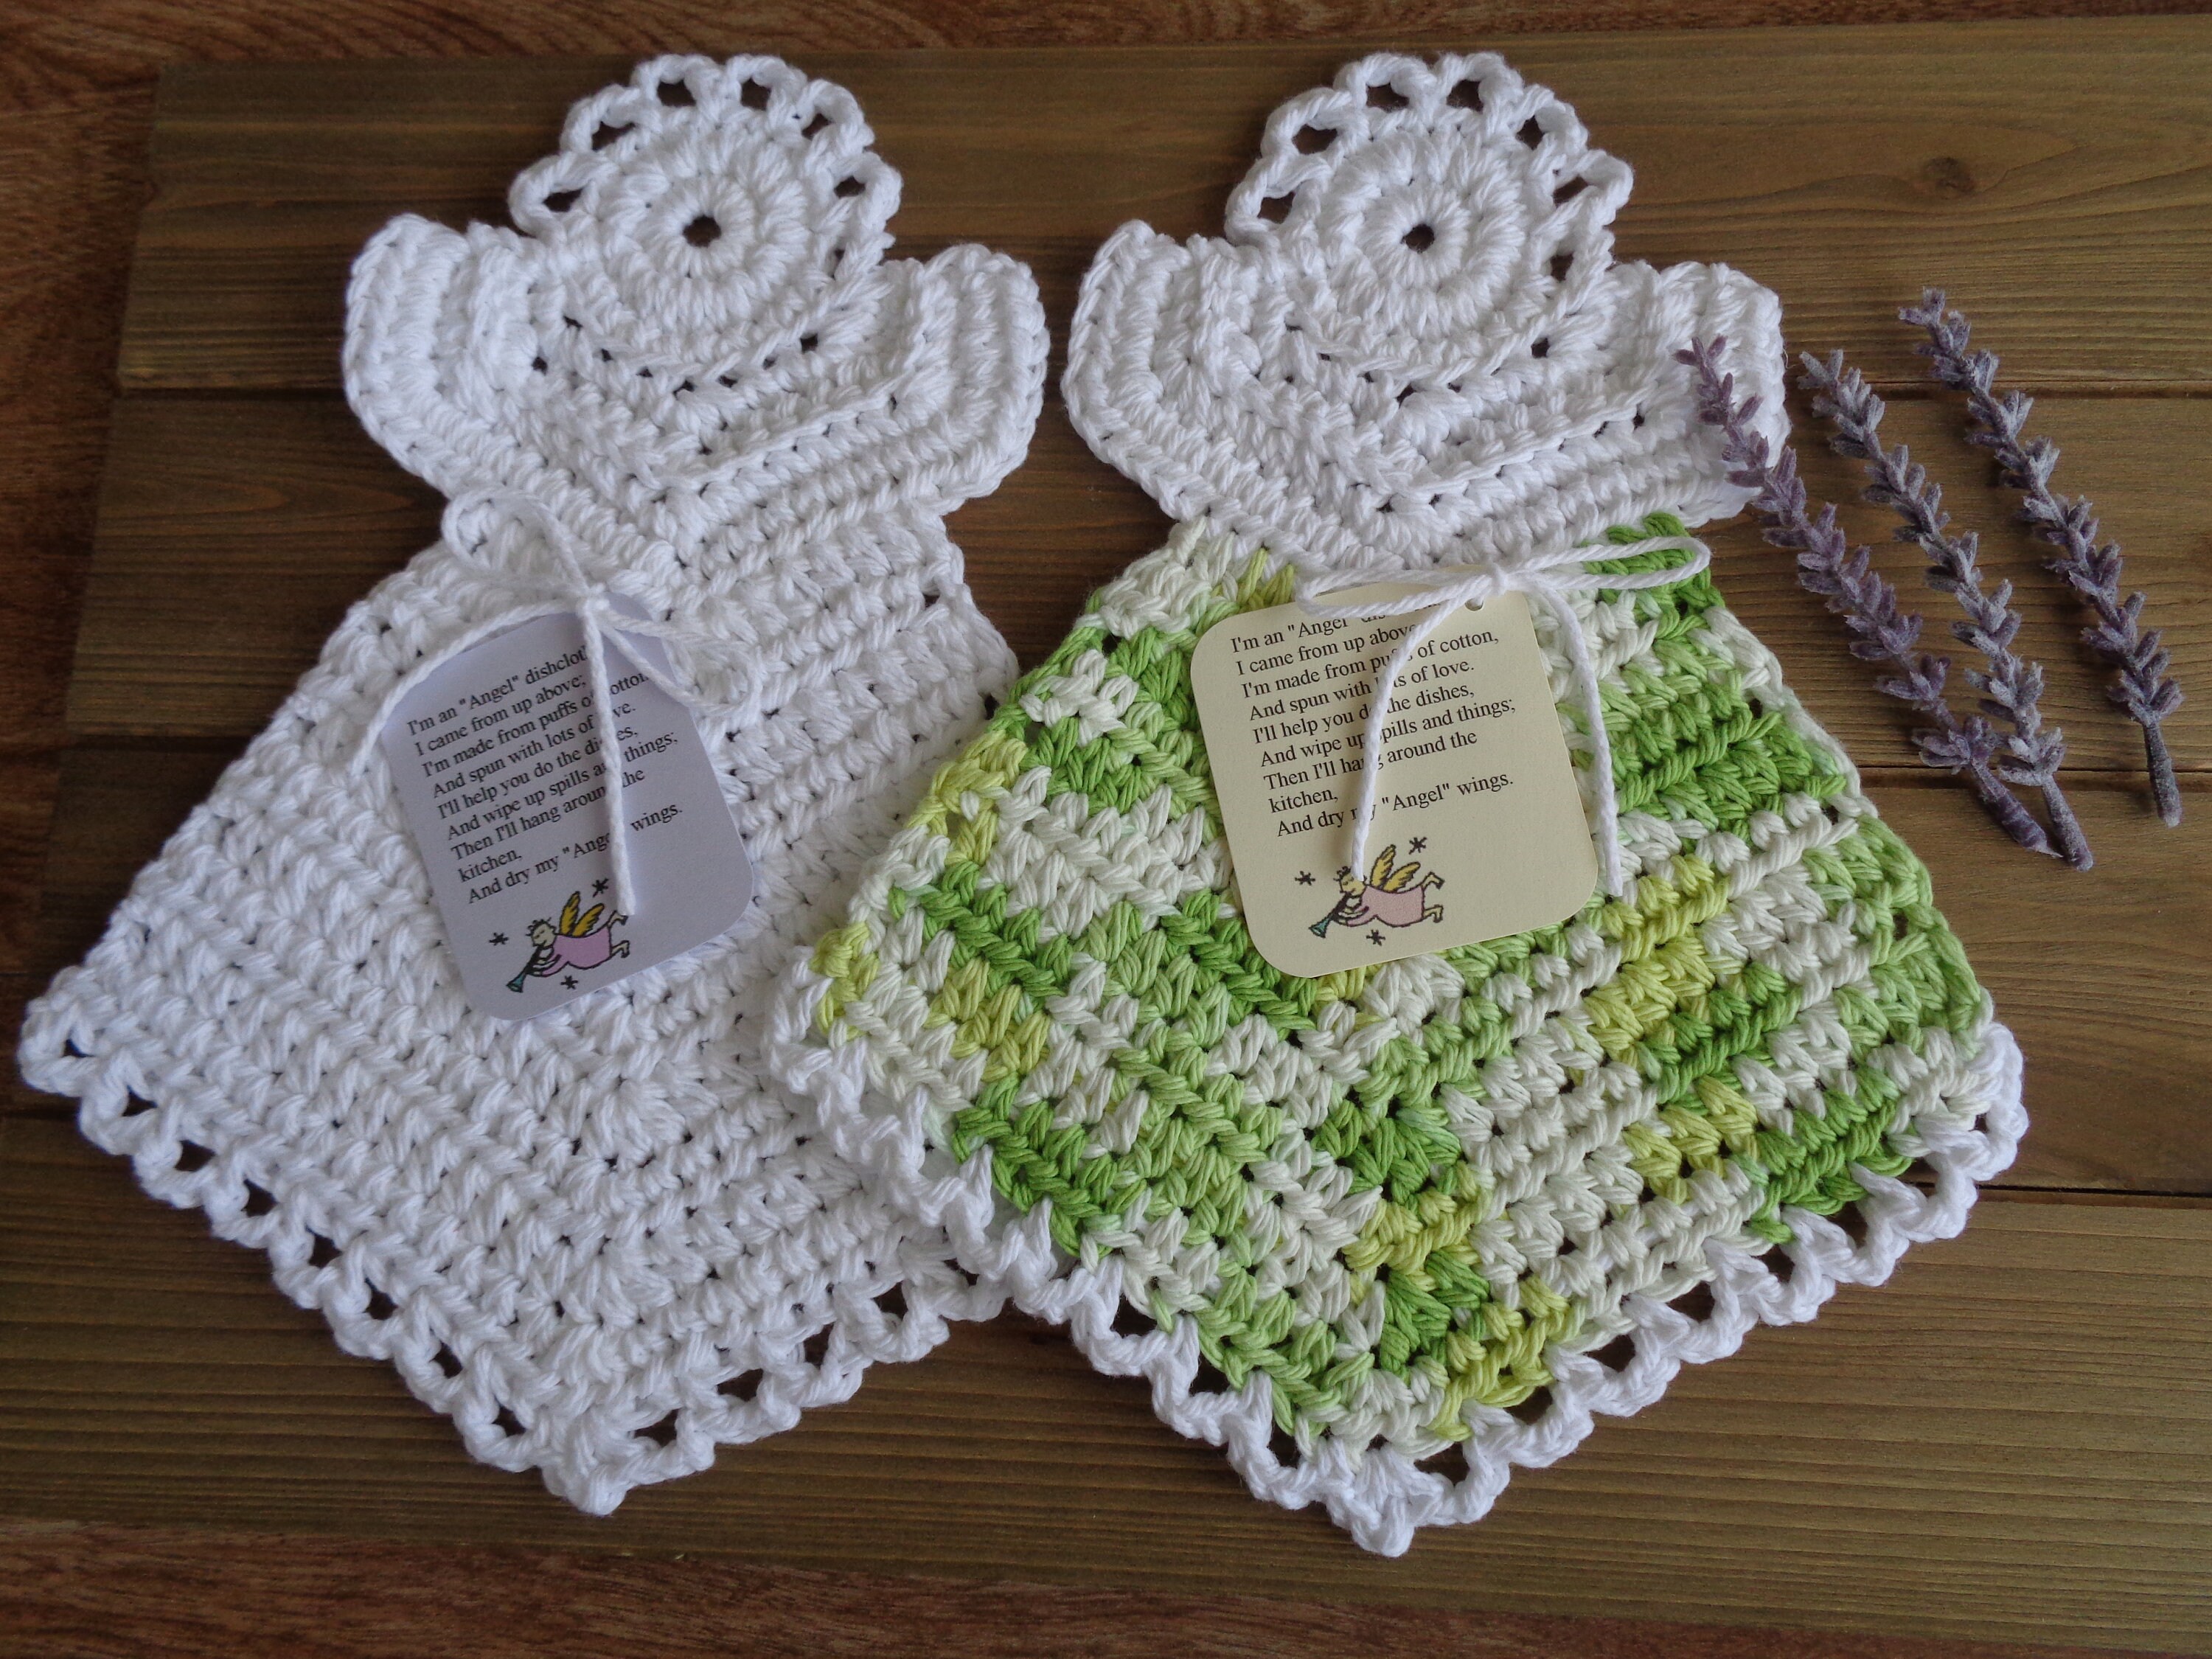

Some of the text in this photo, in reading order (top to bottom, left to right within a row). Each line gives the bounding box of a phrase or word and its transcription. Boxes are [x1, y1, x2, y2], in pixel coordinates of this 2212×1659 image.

[1230, 637, 1260, 653] I'm
[1263, 631, 1285, 646] an
[1236, 661, 1245, 675] I
[1250, 653, 1294, 672] came
[1298, 643, 1340, 662] from
[1342, 637, 1366, 653] up
[1241, 632, 1499, 698] I'm made from of cotton,
[407, 720, 436, 736] I'm
[439, 708, 458, 723] an
[459, 675, 519, 710] "Angel"
[414, 675, 586, 757] I came from up above;
[1250, 699, 1286, 721] And
[1290, 692, 1330, 714] spun
[1332, 681, 1372, 701] with
[1411, 666, 1429, 684] of
[1432, 661, 1475, 679] love.
[1252, 724, 1279, 744] I'll
[1279, 718, 1318, 738] help
[1321, 712, 1355, 732] you
[1416, 685, 1475, 706] dishes,
[422, 761, 451, 778] I'm
[453, 739, 495, 764] made
[498, 721, 537, 745] from
[538, 700, 578, 731] puffs
[434, 773, 466, 799] And
[469, 758, 507, 783] spun
[507, 740, 544, 763] with
[545, 727, 575, 748] lots
[578, 714, 594, 734] of
[1261, 745, 1298, 768] And
[1299, 740, 1342, 758] wipe
[1380, 719, 1418, 744] pills
[1422, 709, 1454, 730] and
[1456, 699, 1516, 722] things;
[1263, 771, 1310, 790] Then
[1312, 760, 1338, 779] I'll
[1387, 735, 1447, 763] around
[1450, 731, 1478, 748] the
[437, 726, 639, 820] I'll help you do the dies,
[448, 732, 678, 841] And wipe up spills things;
[1276, 814, 1314, 837] And
[1318, 811, 1344, 828] dry
[1382, 783, 1450, 811] "Angel"
[1456, 774, 1514, 796] wings.
[450, 836, 494, 860] Then
[495, 821, 519, 842] I'll
[519, 807, 562, 831] hang
[563, 786, 607, 813] aroun
[469, 877, 503, 904] And
[505, 869, 530, 888] dry
[535, 856, 560, 874] my
[630, 804, 683, 831] wings.
